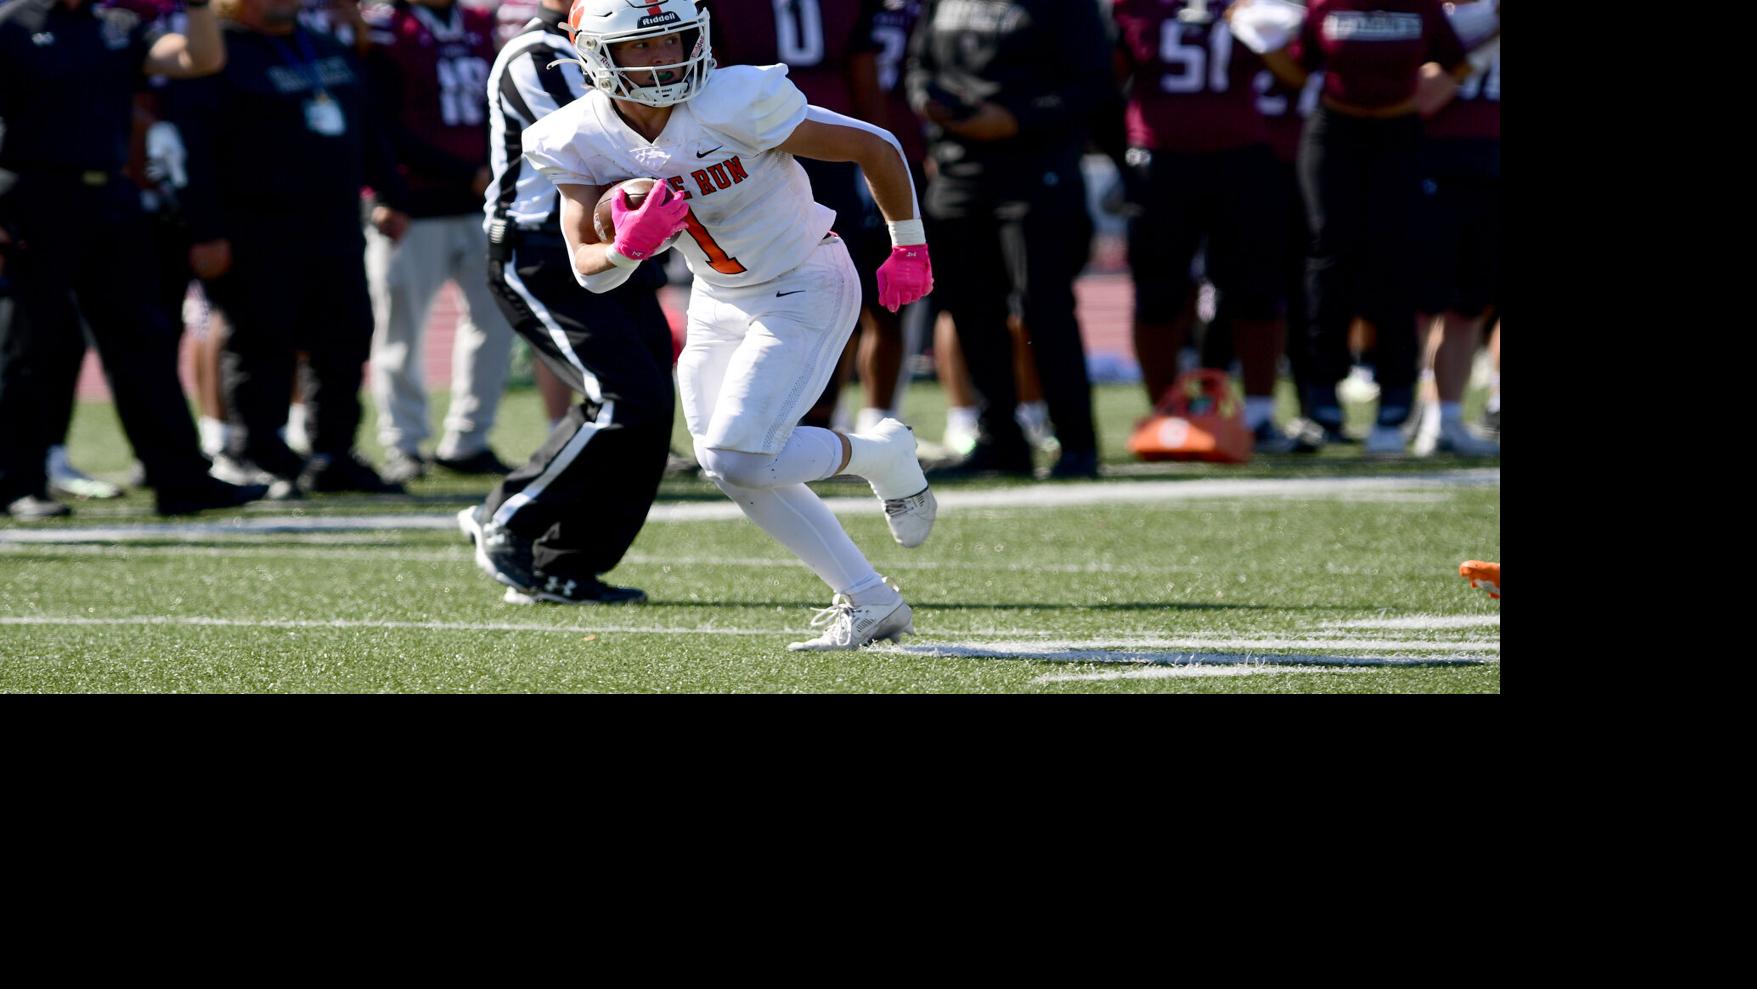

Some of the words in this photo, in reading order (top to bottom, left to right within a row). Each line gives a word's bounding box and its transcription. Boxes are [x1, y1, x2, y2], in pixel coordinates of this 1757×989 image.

[642, 12, 676, 26] Riddell
[1160, 18, 1233, 93] 51
[691, 155, 749, 196] RUN
[683, 205, 748, 275] 1
